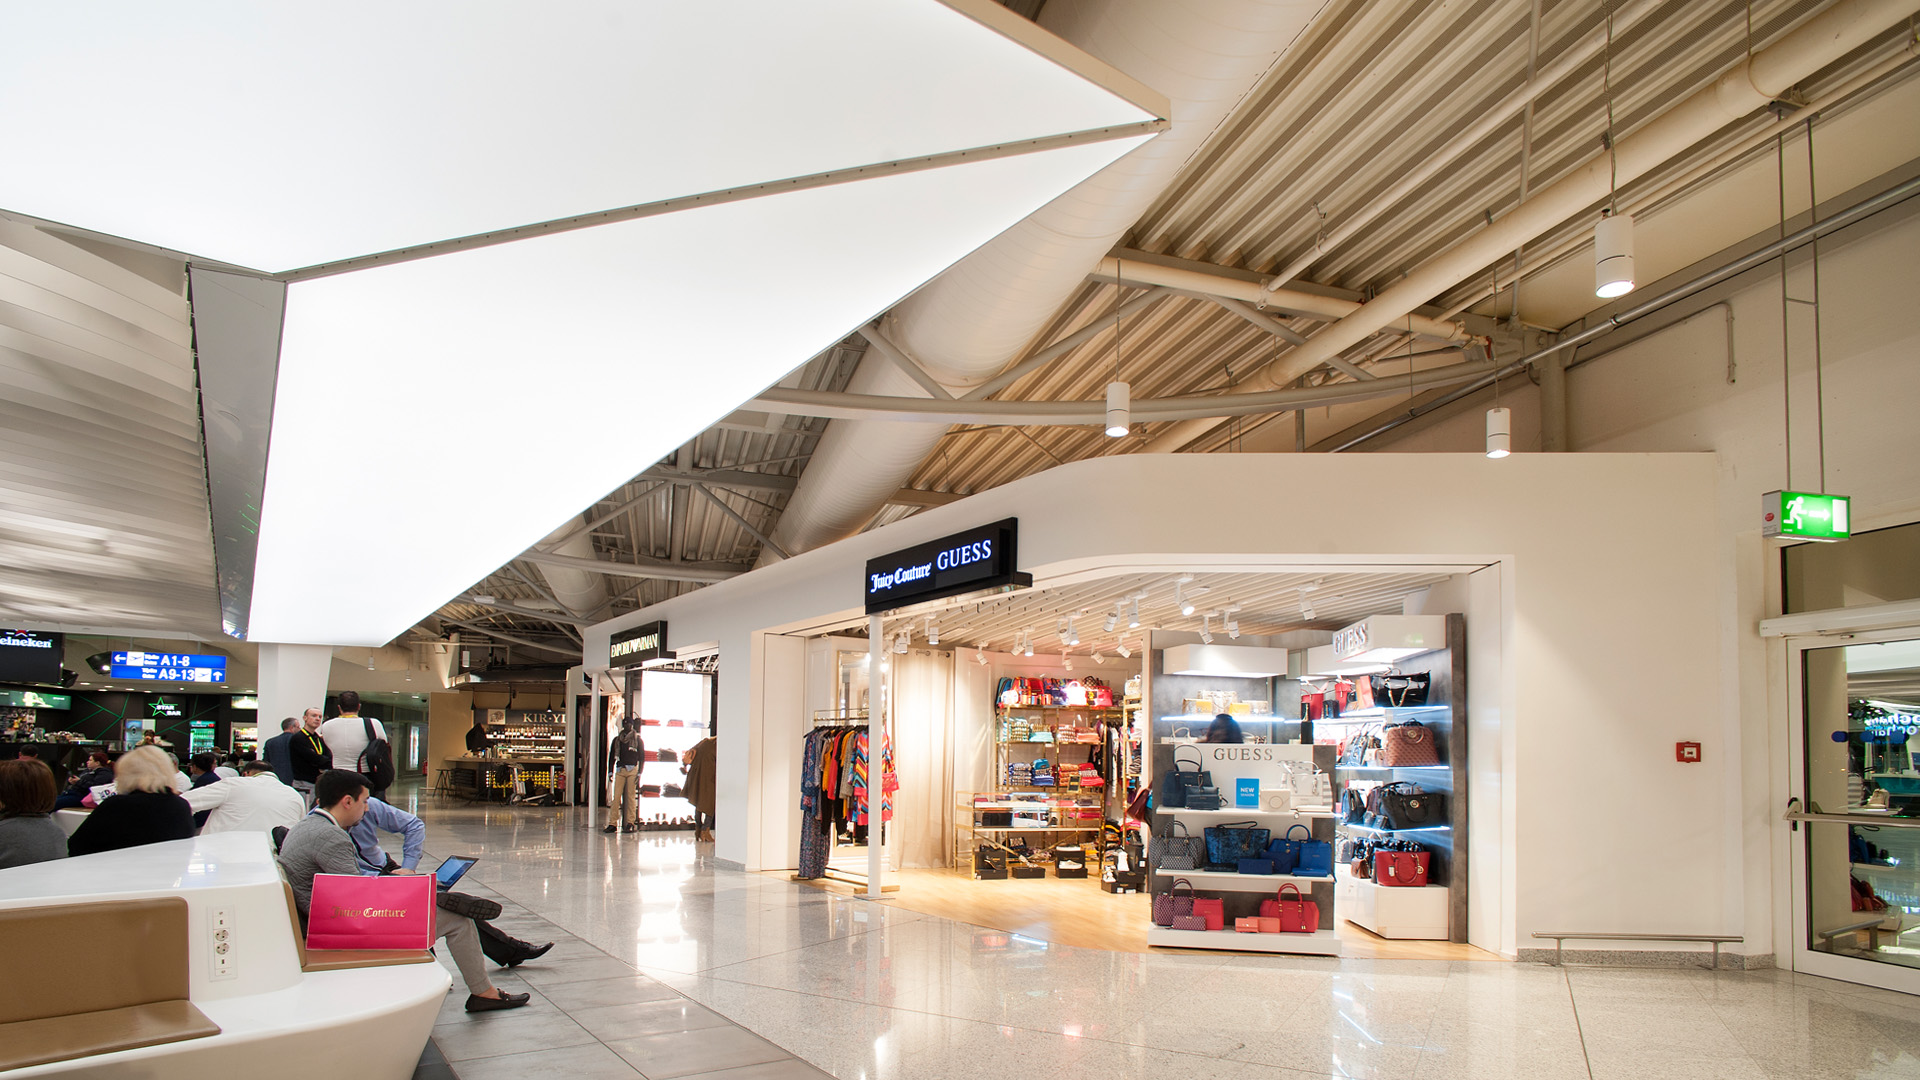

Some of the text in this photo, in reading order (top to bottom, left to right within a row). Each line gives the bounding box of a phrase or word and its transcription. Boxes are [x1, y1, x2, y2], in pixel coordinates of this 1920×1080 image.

[870, 539, 992, 593] Juicy Couture GUESS
[0, 636, 52, 648] eineken
[1335, 624, 1368, 654] GUESS
[160, 654, 190, 666] A1-8
[158, 668, 195, 681] A9-13
[1213, 747, 1273, 761] GUESS
[330, 906, 406, 919] Juicy Couture
